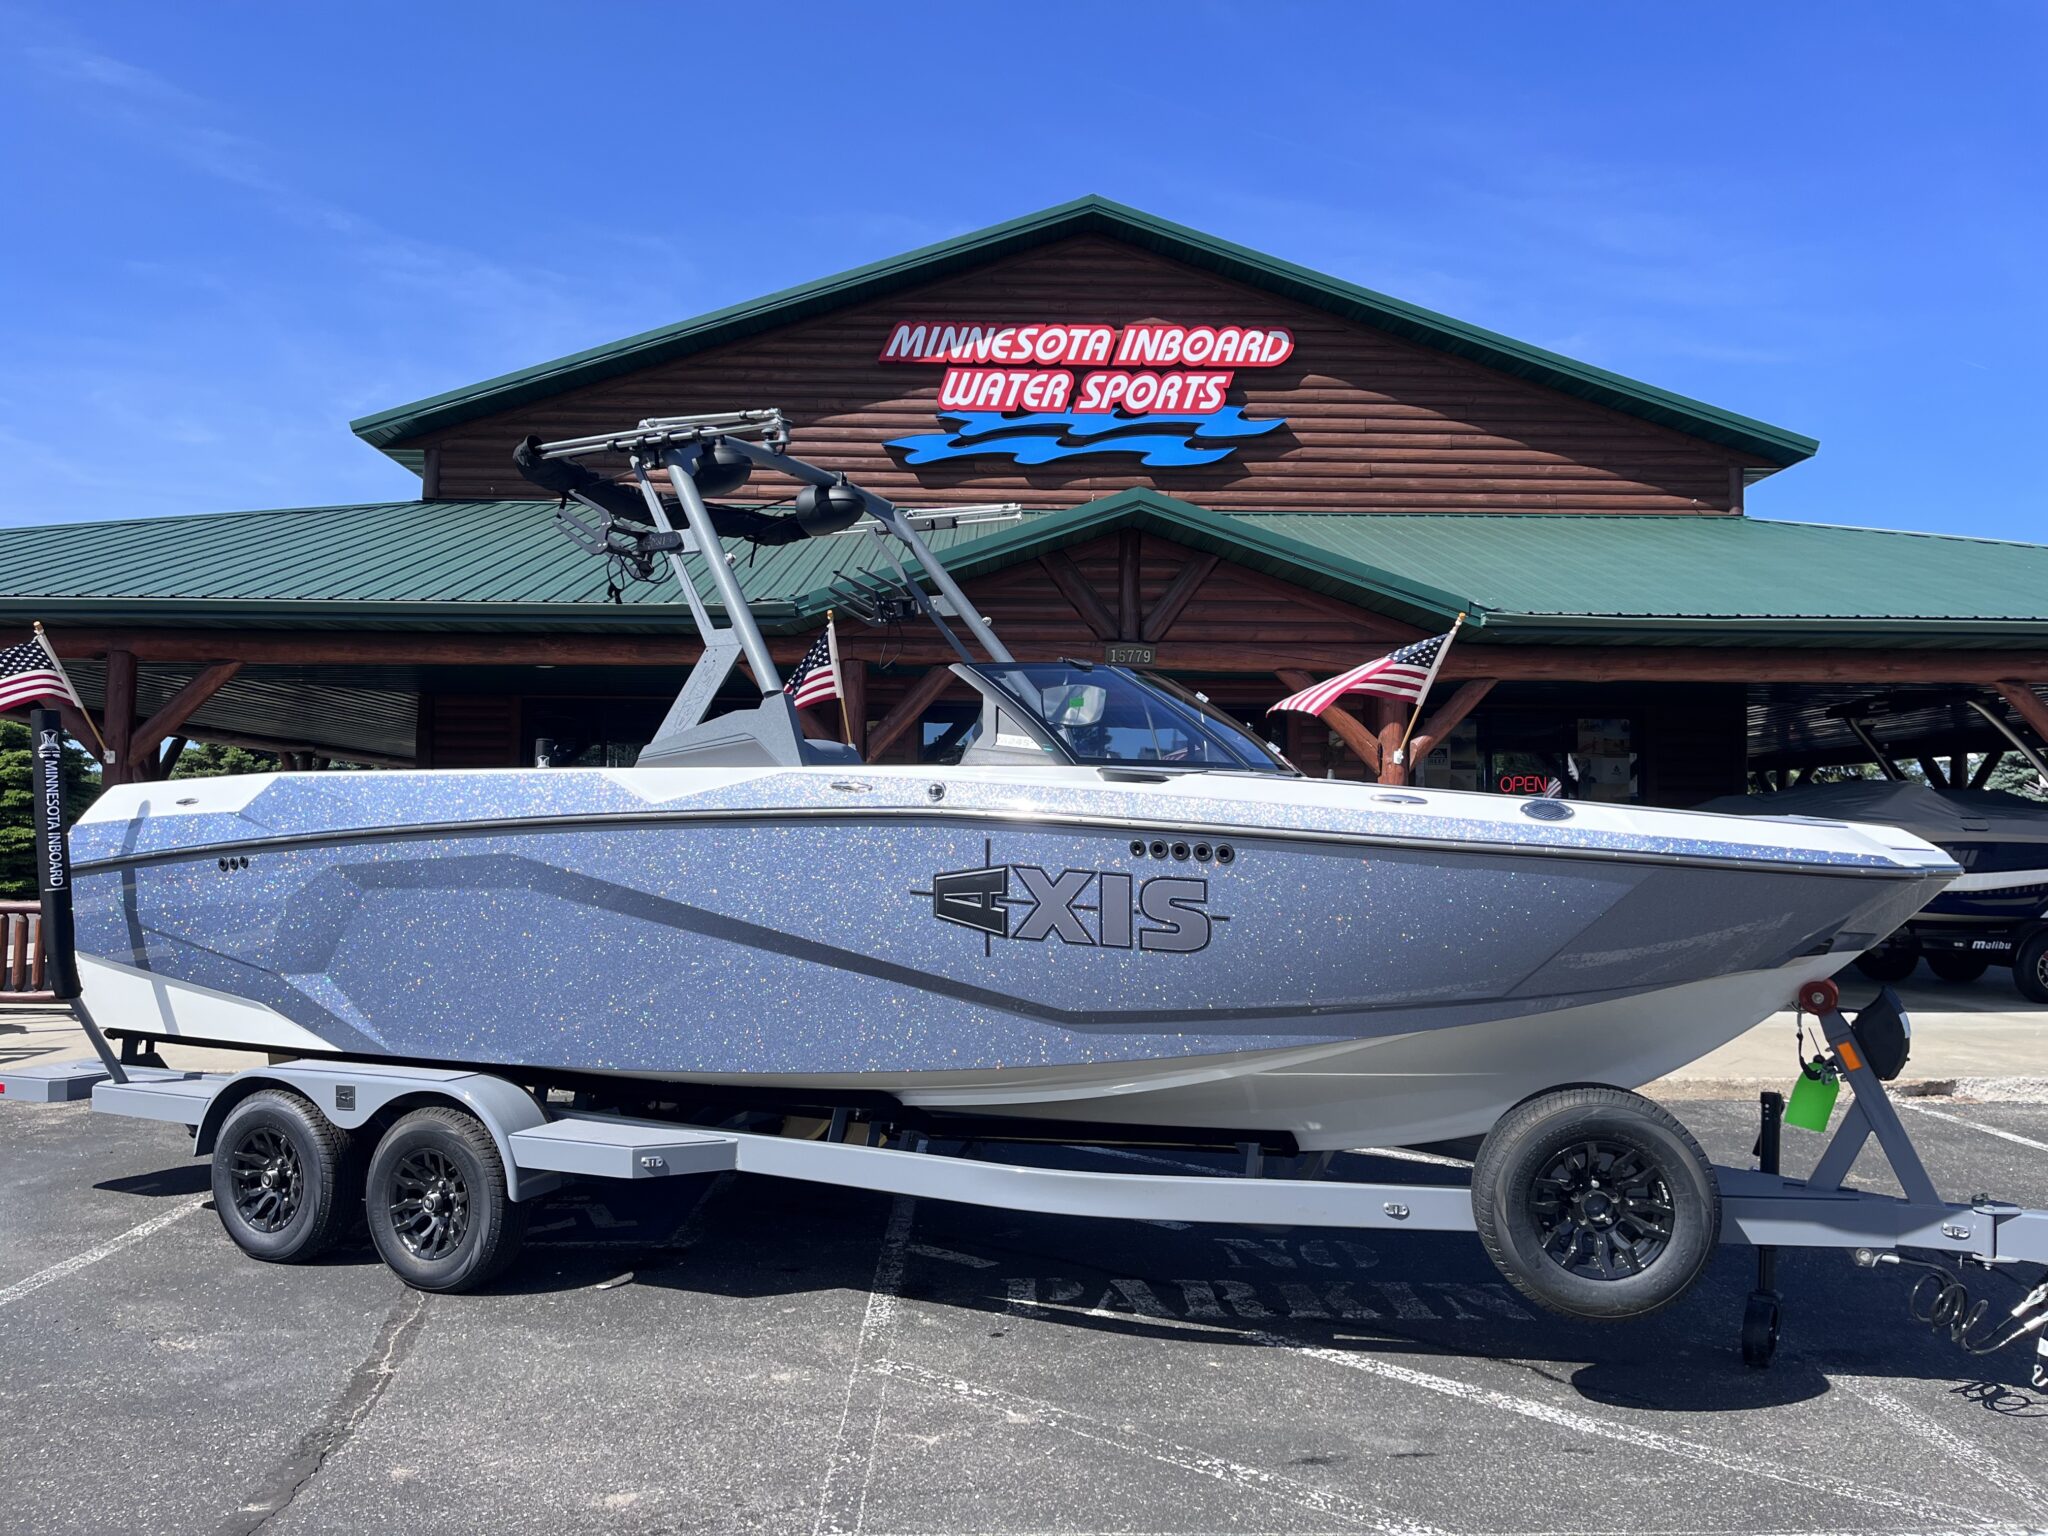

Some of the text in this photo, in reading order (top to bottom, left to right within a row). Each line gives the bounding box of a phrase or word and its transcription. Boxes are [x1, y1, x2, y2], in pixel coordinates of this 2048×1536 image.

[886, 325, 1290, 363] MINNESOTA INBOARD
[942, 370, 1228, 409] WATER SPORTS
[1499, 776, 1548, 793] OPEN
[45, 760, 63, 887] MINNESOTA INBOARD
[934, 863, 1212, 953] AXIS
[1972, 940, 2012, 950] Malibu
[1214, 1238, 1380, 1269] NO
[998, 1277, 1538, 1322] PARKIN
